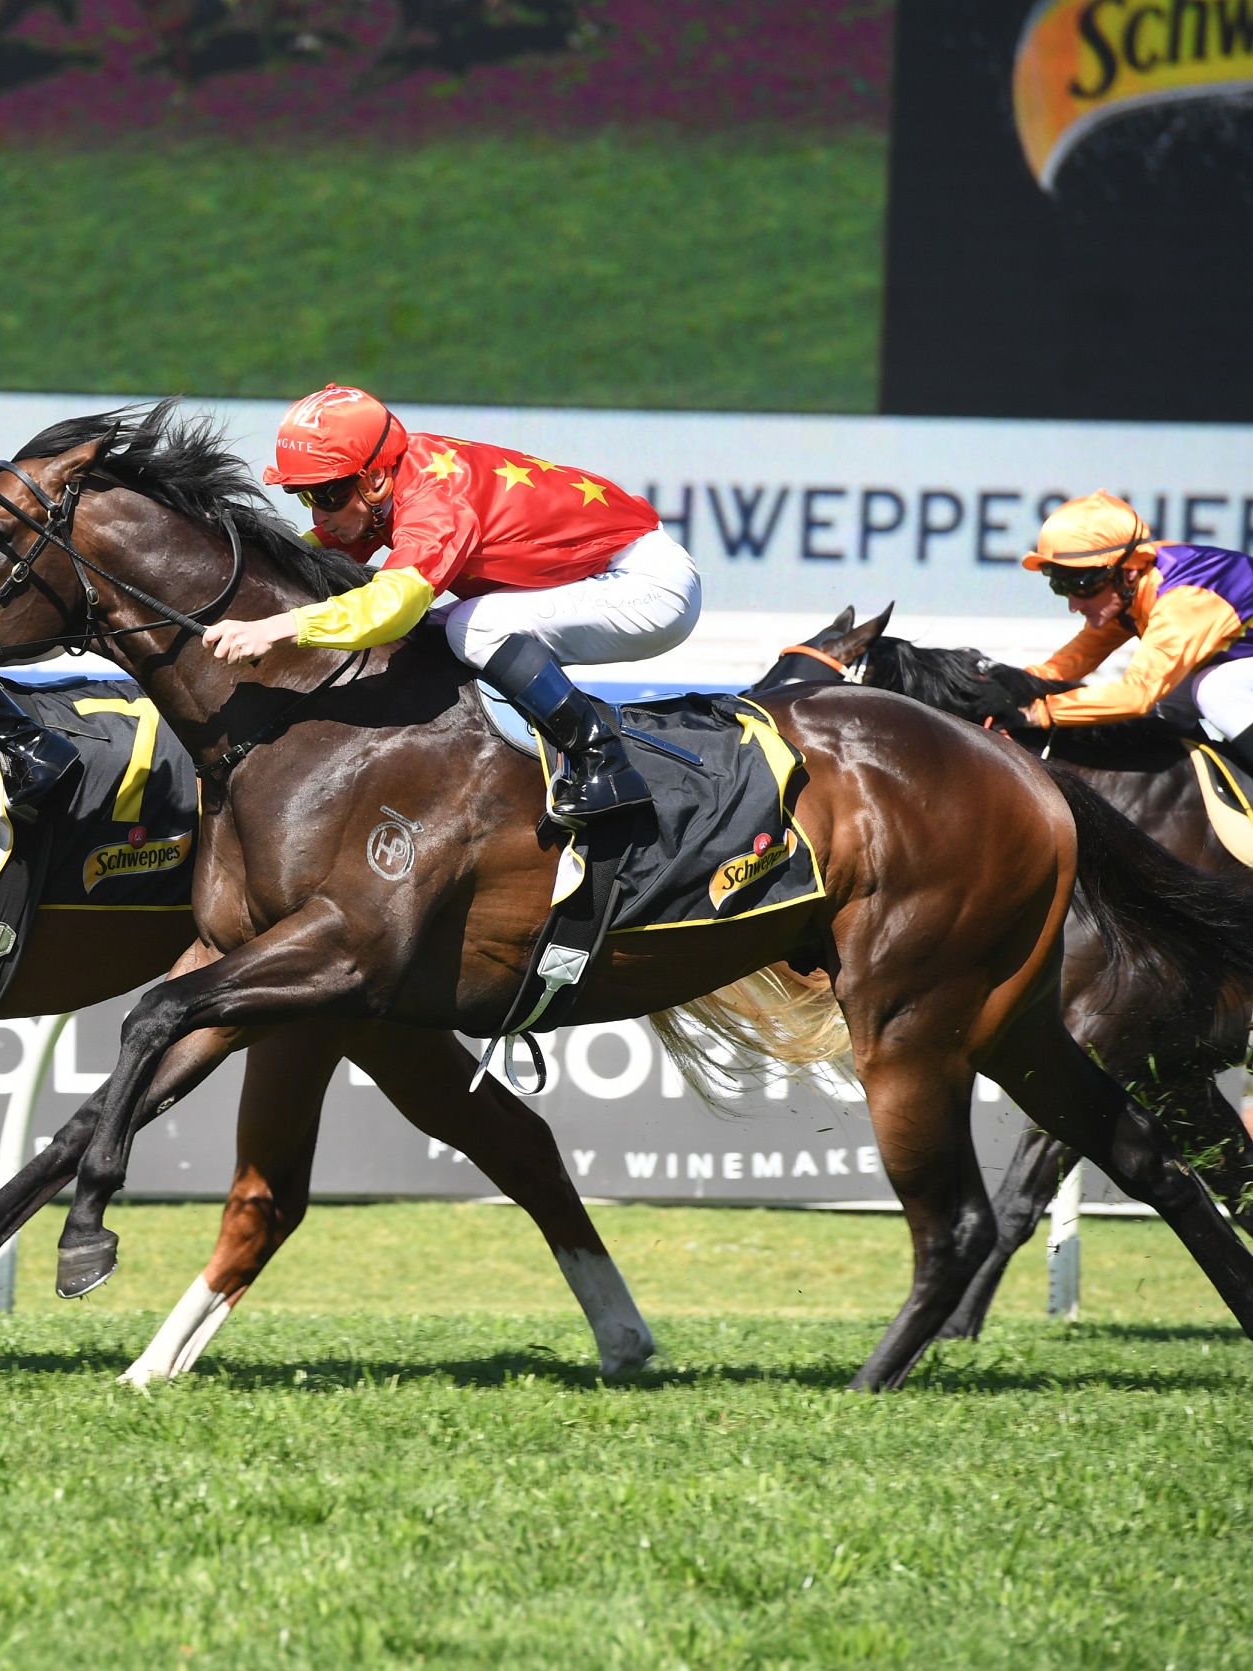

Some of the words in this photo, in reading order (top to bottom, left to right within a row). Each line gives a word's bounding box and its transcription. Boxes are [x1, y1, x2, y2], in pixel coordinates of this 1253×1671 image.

[95, 844, 180, 876] Schweppes
[722, 846, 788, 890] Schwepp
[625, 1146, 880, 1180] WINEMAKE
